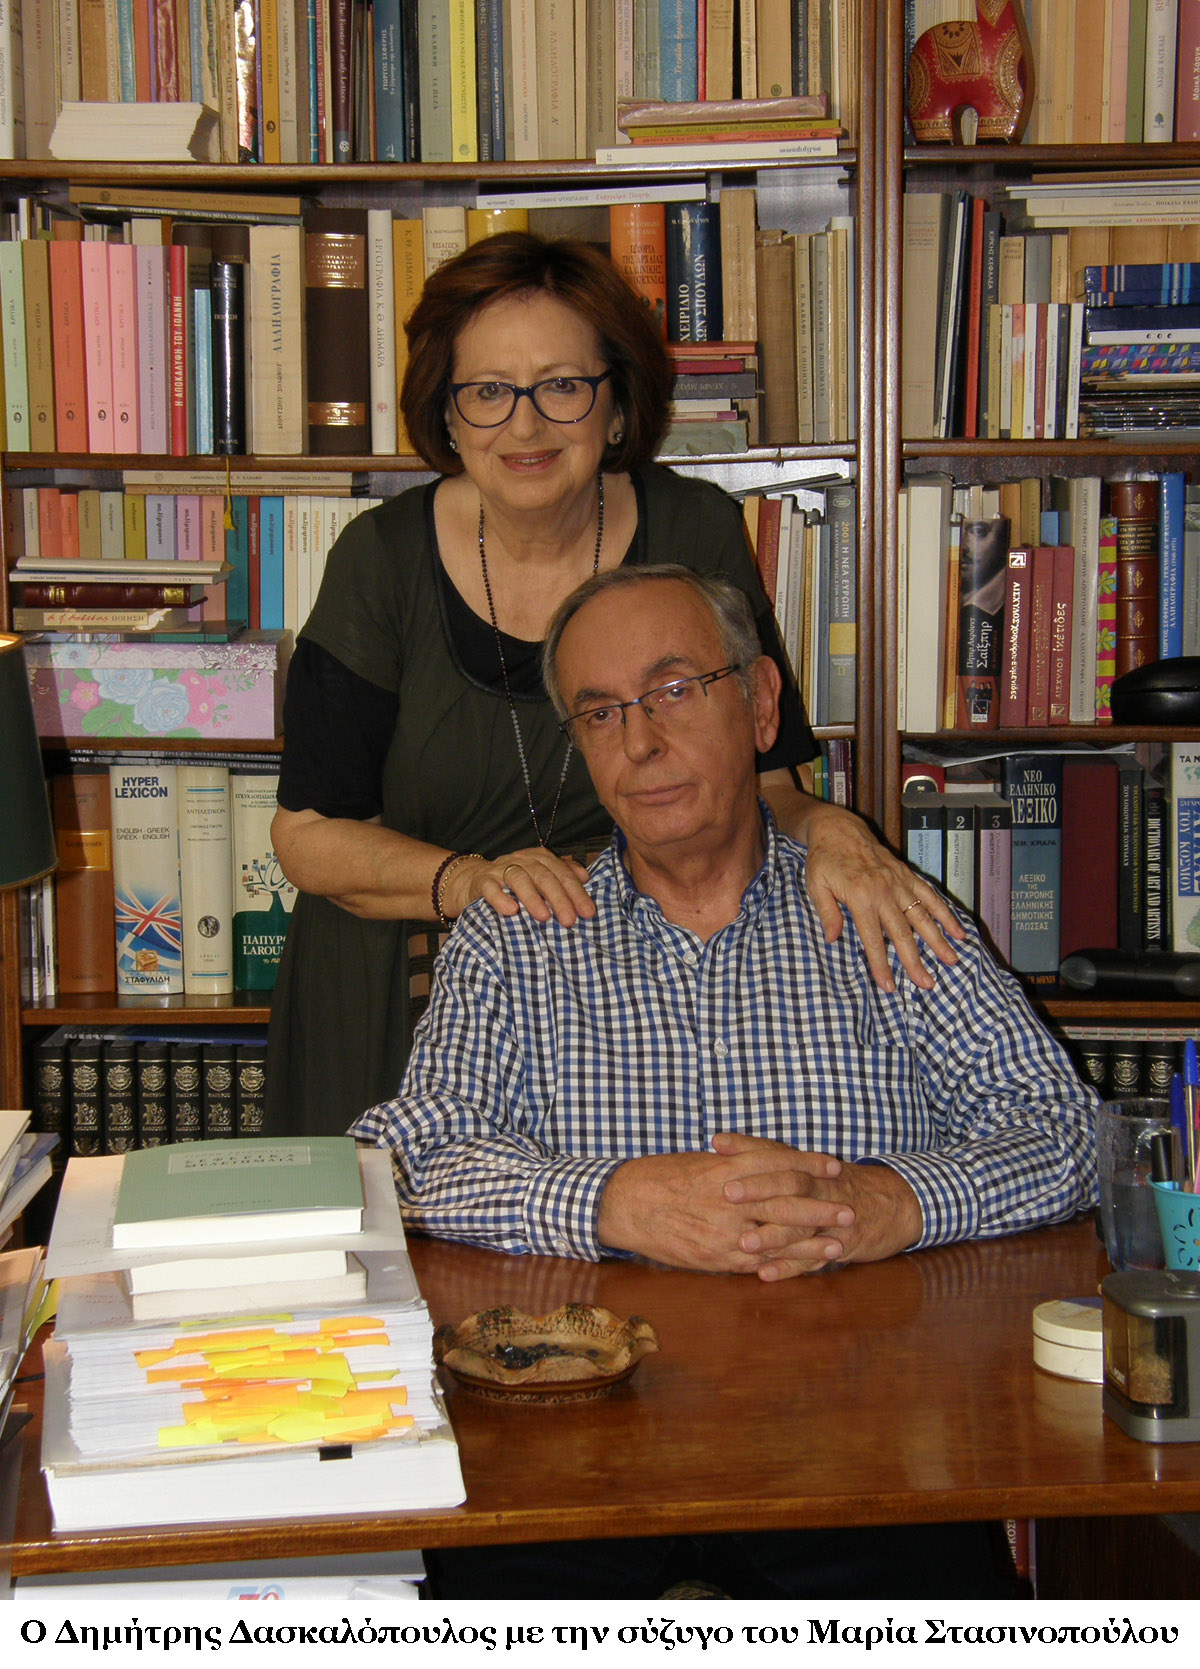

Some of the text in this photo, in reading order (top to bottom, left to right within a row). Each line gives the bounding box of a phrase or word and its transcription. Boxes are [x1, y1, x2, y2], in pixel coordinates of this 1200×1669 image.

[1156, 35, 1165, 88] ΝΑΣΟΣ ΒΑΓΕΝΑΣ
[550, 30, 559, 110] ΑΛΛΗΛΟΓΡΑΦΙΑ
[432, 78, 438, 87] ΤΑ
[630, 245, 655, 254] ΙΣΤΟΡΙΑ
[987, 230, 995, 256] ΚΙΡΚΗΣ
[622, 255, 663, 264] ΤΗΣ ΑΡΧΑΙΑΣ
[375, 238, 384, 300] ΕΡΓΟΓΡΑΦΙΑ
[404, 249, 414, 297] ΔΗΜΑΡΑΣ
[986, 257, 995, 289] ΚΕΦΑΛΕΑ
[694, 254, 707, 317] ΣΠΟΥΔΩΝ
[271, 254, 282, 353] ΑΛΛΗΛΟΓΡΑΦΙΑ
[172, 296, 182, 328] ΙΩΑΝΝΗ
[173, 331, 182, 345] ΤΟΥ
[376, 325, 386, 368] ΔΗΜΑΡΑ
[801, 346, 807, 354] ΤΑ
[819, 342, 825, 353] ΤΑ
[174, 348, 183, 398] ΑΠΟΚΑΛΥΨΗ
[841, 521, 850, 543] 2003
[842, 557, 850, 575] ΝΕΑ
[842, 579, 851, 618] ΕΥΡΩΠΗ
[1011, 581, 1021, 624] ΑΙΣΧΥΛΟΣ
[1169, 568, 1177, 630] ΑΛΛΗΛΟΓΡΑΦΙΑ
[111, 614, 144, 622] ΠΟΙΗΣΗ
[1162, 596, 1170, 628] ΣΕΦΕΡΗΣ
[975, 621, 992, 668] Σαίξπηρ
[1162, 629, 1170, 656] ΓΙΩΡΓΟΣ
[965, 647, 976, 669] Πήτερ
[1055, 657, 1064, 698] ΑΙΣΧΥΛΟΣ
[1179, 755, 1191, 763] ΤΑ
[122, 776, 159, 788] HYPER
[1023, 770, 1043, 783] ΝΕΟ
[115, 786, 168, 799] LEXICON
[1009, 784, 1057, 797] ΕΛΛΗΝΙΚΟ
[186, 807, 226, 815] ΑΝΤΙΛΕΞΙΚΟΝ
[1011, 798, 1058, 824] ΛΕΞΙΚΟ
[921, 814, 929, 829] 1
[956, 814, 965, 829] 2
[991, 814, 1000, 829] 3
[1030, 839, 1057, 847] ΚΡΙΑΡΑ
[1179, 809, 1191, 893] ΤΟΥ ΚΟΣΜΟΥ
[1018, 873, 1046, 883] ΛΕΞΙΚΟ
[1026, 882, 1038, 890] ΤΗΣ
[1147, 818, 1161, 940] DICTIONARY OF ART AND ARTISTS
[1011, 890, 1054, 899] ΣΥΓΧΡΟΝΗΣ
[1011, 900, 1054, 910] ΕΛΛΗΝΙΚΗΣ
[1011, 911, 1054, 921] ΔΗΜΟΤΙΚΗΣ
[1015, 921, 1049, 932] ΓΛΩΣΣΑΣ
[124, 975, 170, 984] ΣΤΑΦΥΛΙΔΗ
